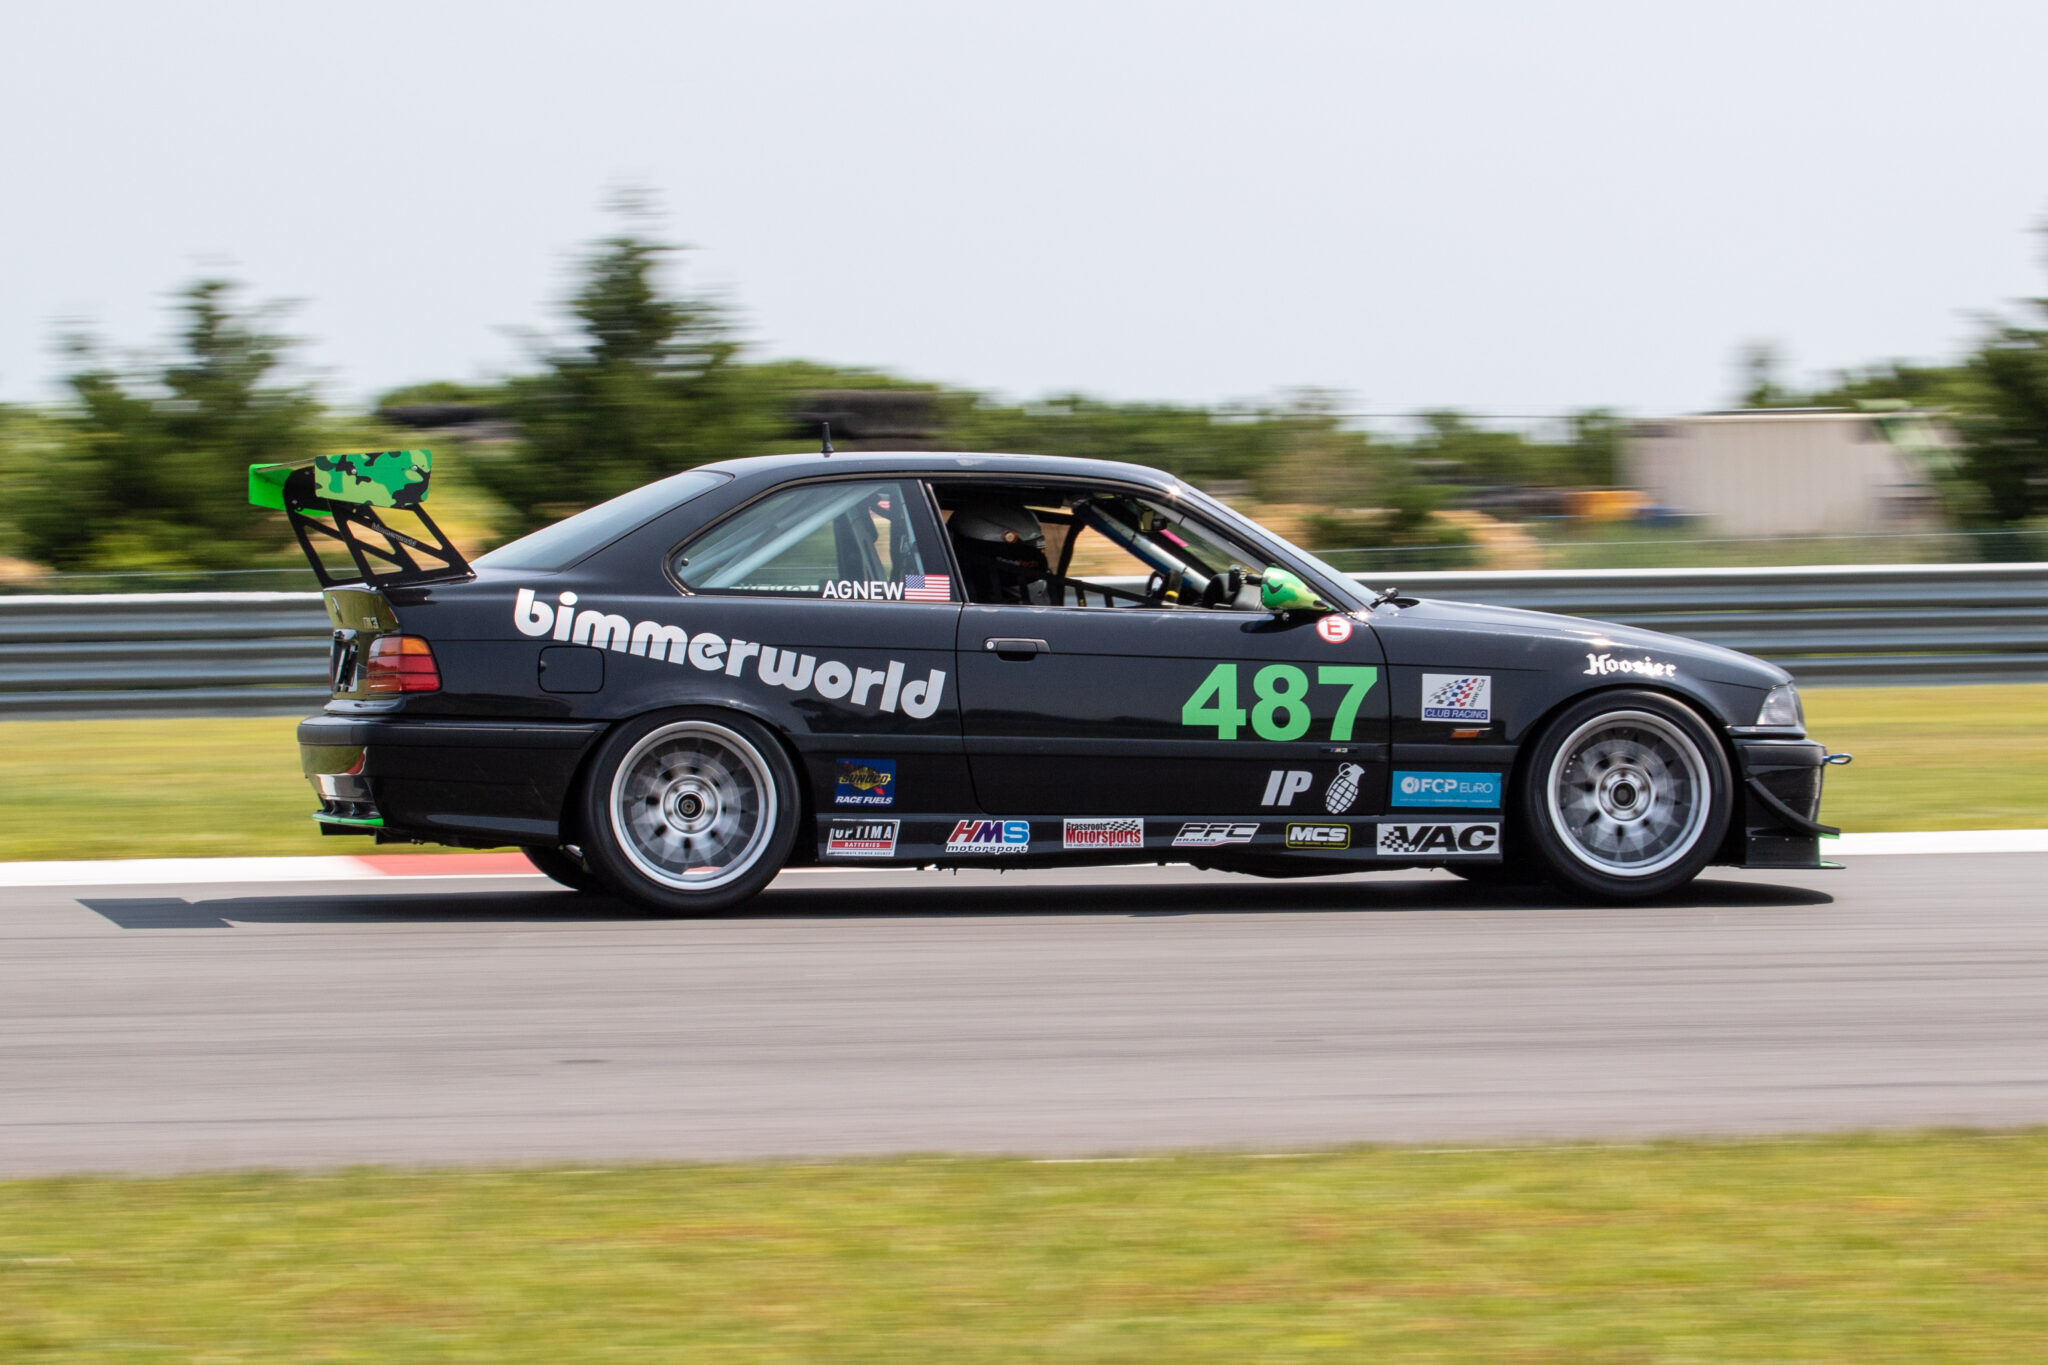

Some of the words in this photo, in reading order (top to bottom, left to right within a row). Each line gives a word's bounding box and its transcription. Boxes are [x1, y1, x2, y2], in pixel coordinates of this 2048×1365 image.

[822, 580, 904, 600] AGNEW
[1326, 619, 1343, 636] E
[513, 588, 946, 719] bimmerworld
[1583, 653, 1678, 677] Hoosier
[1182, 663, 1378, 742] 487
[1425, 708, 1450, 718] CLUB
[1451, 709, 1487, 719] RACING
[1261, 770, 1313, 806] IP
[1421, 778, 1457, 793] FCP
[1460, 782, 1494, 793] EURO
[835, 796, 862, 804] RACE
[863, 797, 893, 805] FUELS
[948, 820, 1030, 843] HMS
[1066, 822, 1107, 830] Grassroots
[1177, 824, 1258, 837] PFC
[1290, 826, 1347, 841] MCS
[1065, 829, 1141, 846] Motorsports
[1381, 825, 1497, 852] VAC
[946, 844, 1028, 854] motorsport
